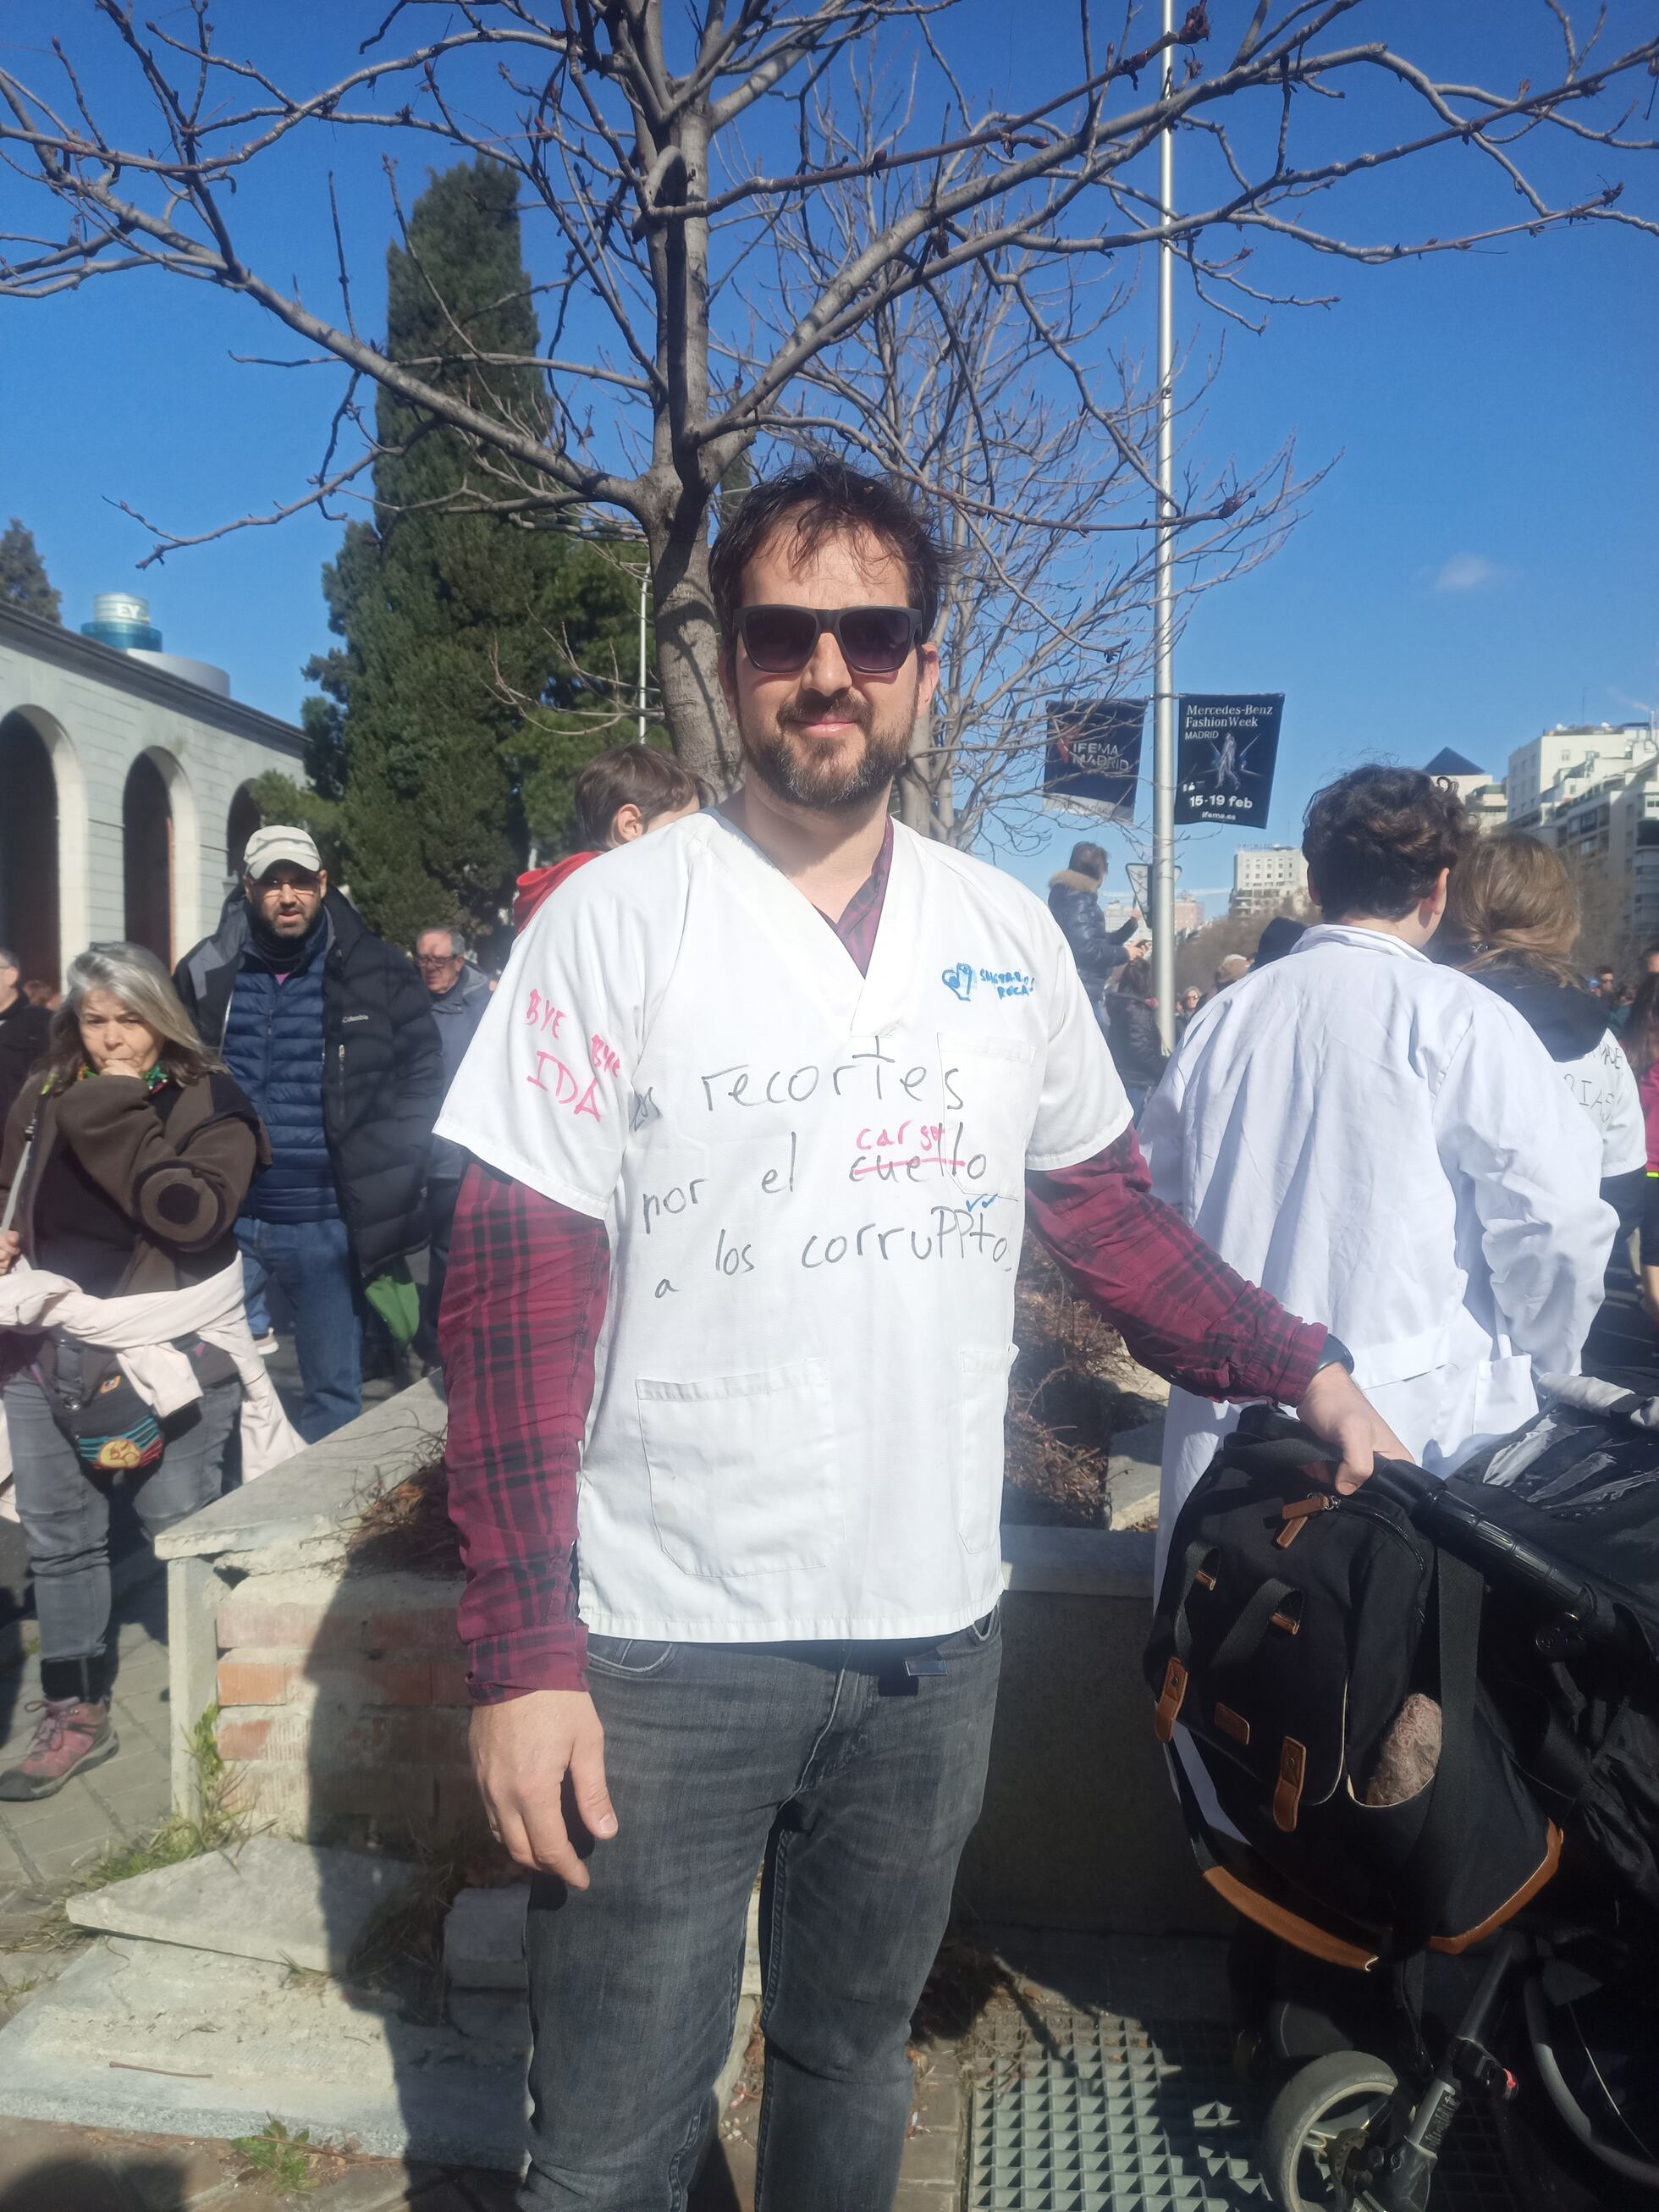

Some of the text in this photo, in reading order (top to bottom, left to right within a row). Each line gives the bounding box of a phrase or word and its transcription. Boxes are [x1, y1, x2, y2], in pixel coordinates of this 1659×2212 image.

[117, 602, 140, 619] EY
[1186, 704, 1274, 716] Mercedes-Benz
[1185, 716, 1259, 728] Fashion Week
[1185, 731, 1219, 740] MADRID
[1073, 743, 1118, 755] IFEMA
[1072, 754, 1129, 771] MADRID
[1229, 796, 1253, 809] feb
[522, 988, 566, 1040] BYE
[701, 1035, 965, 1111] recortes
[526, 1051, 601, 1123] IDA
[762, 1131, 796, 1193] el
[654, 1278, 678, 1299] a
[715, 1229, 756, 1276] los
